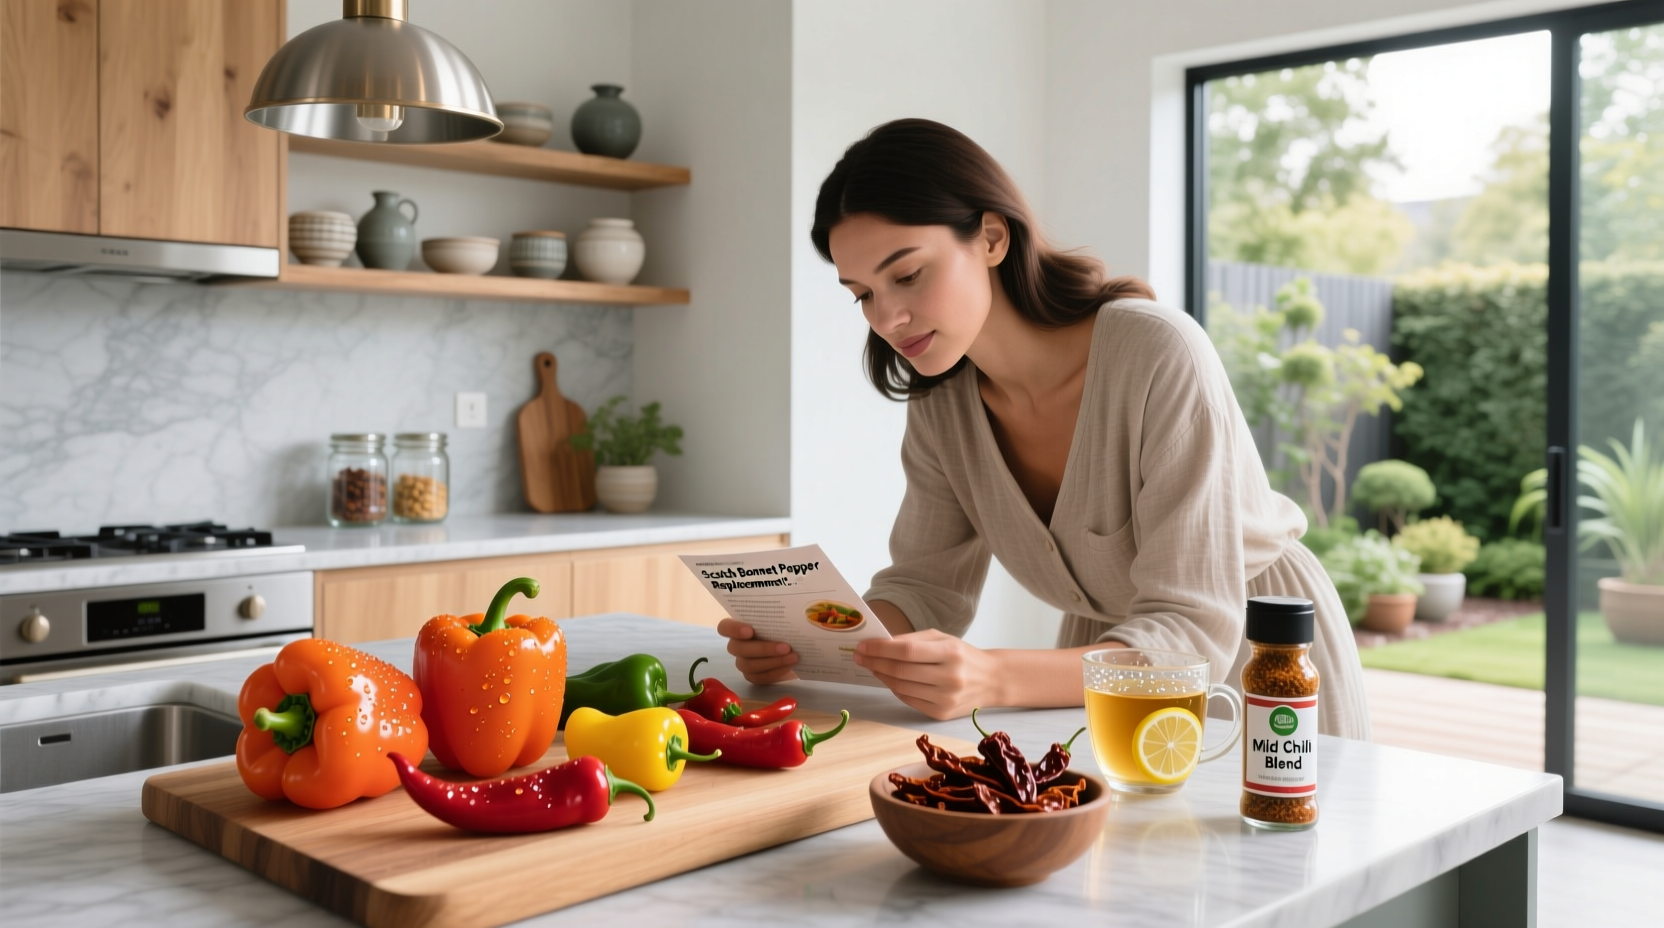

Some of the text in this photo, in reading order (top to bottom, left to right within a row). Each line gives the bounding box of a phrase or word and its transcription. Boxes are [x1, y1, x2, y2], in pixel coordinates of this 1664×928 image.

[737, 565, 778, 578] Bonnet
[1253, 738, 1312, 754] Mid Chili
[1265, 755, 1302, 770] Blend
